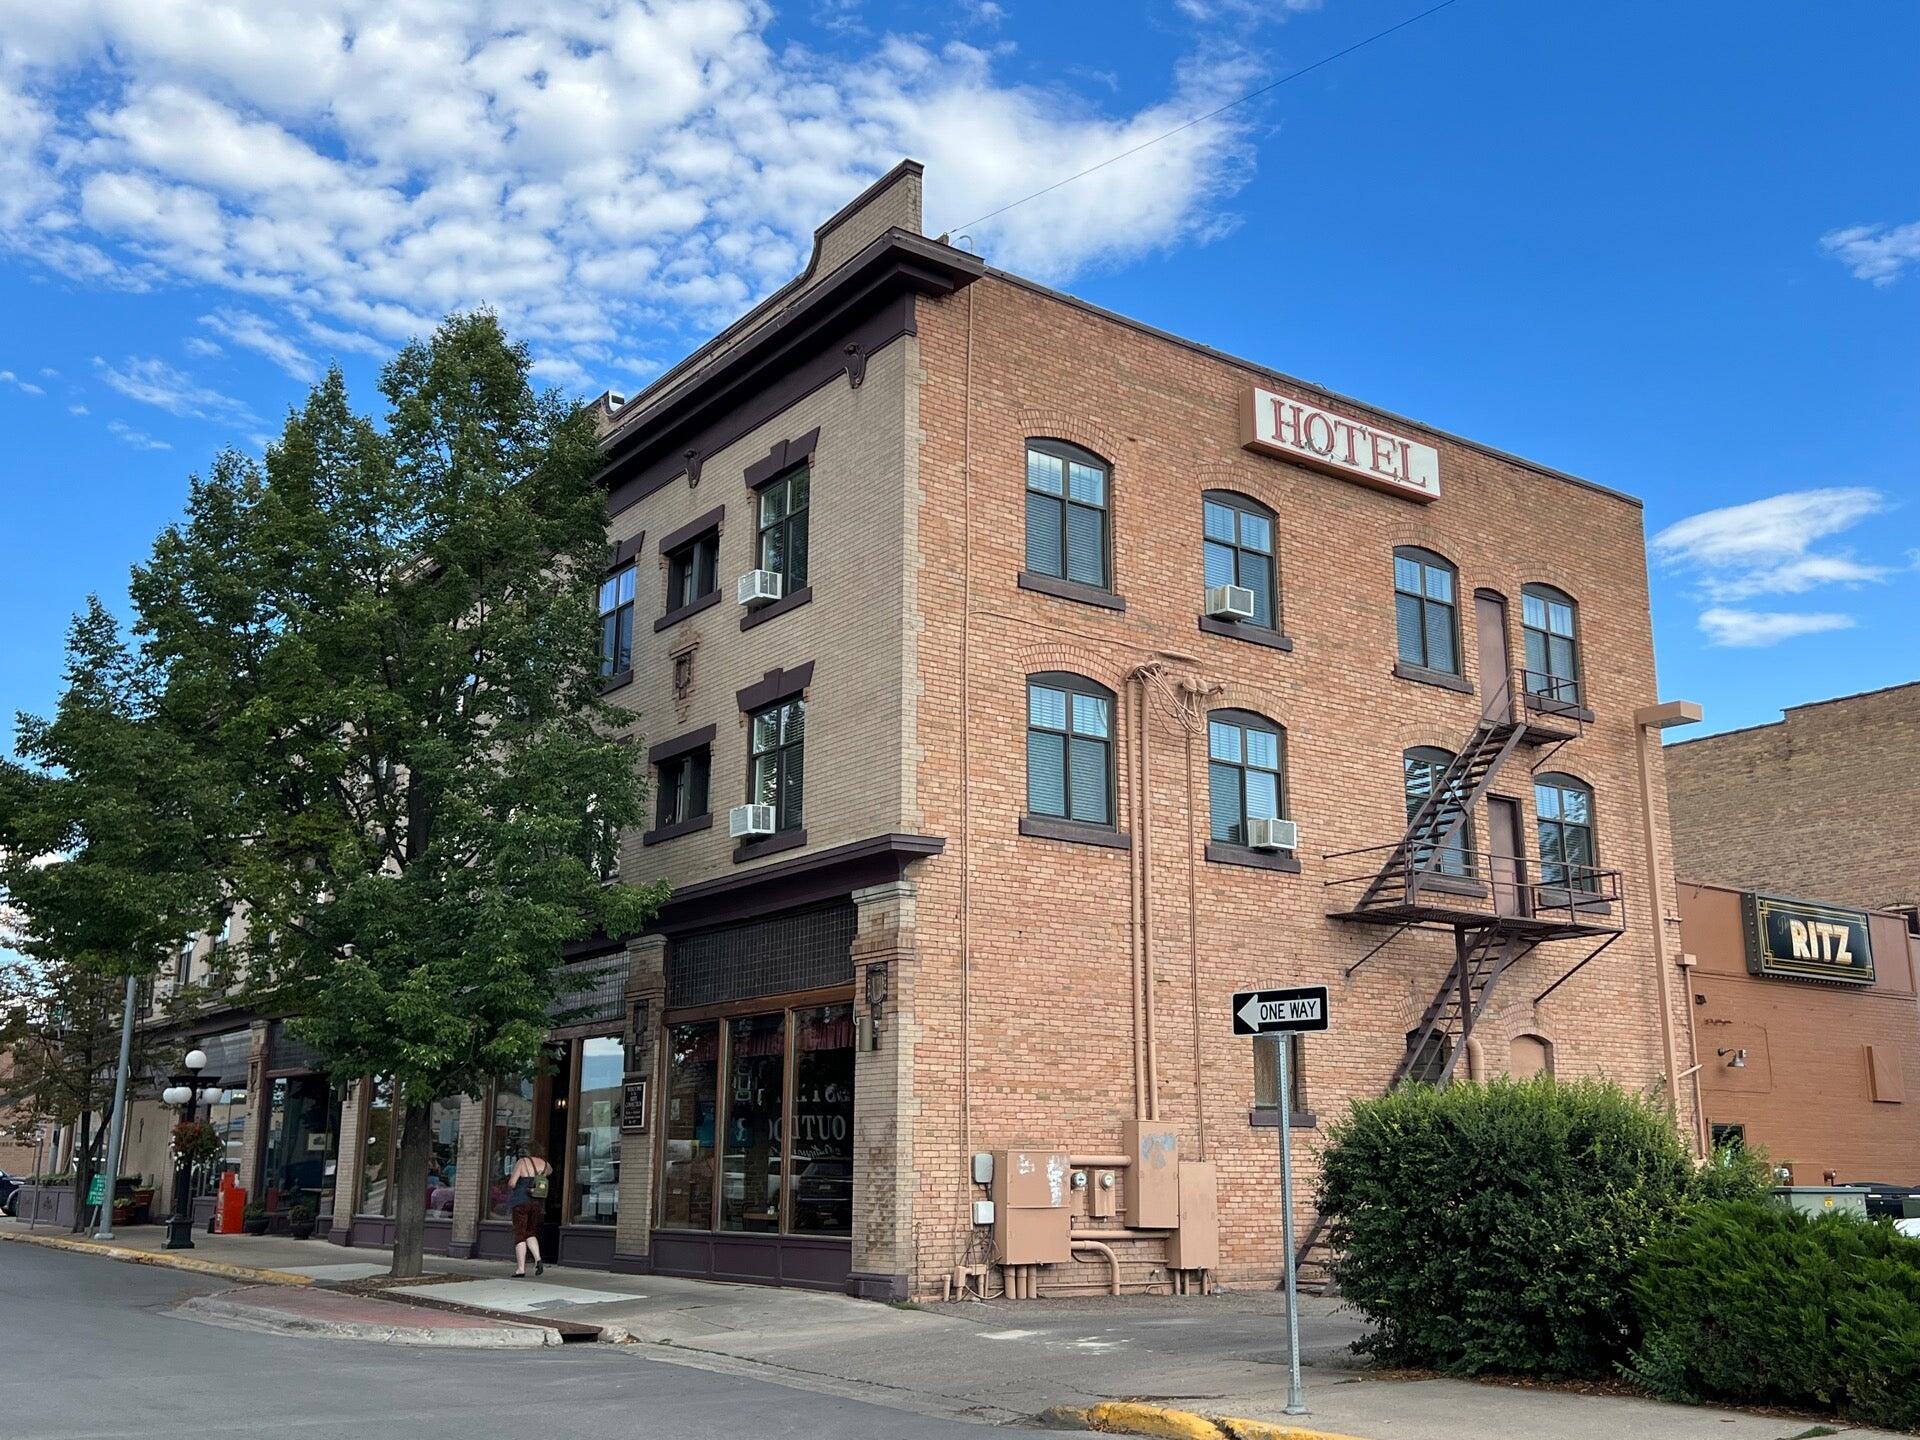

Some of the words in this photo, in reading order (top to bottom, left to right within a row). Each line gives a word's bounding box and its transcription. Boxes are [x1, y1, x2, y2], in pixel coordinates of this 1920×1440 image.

[1271, 398, 1427, 488] HOTEL
[1789, 919, 1853, 965] RITZ
[1260, 1003, 1286, 1020] ONE
[1290, 1001, 1317, 1018] WAY
